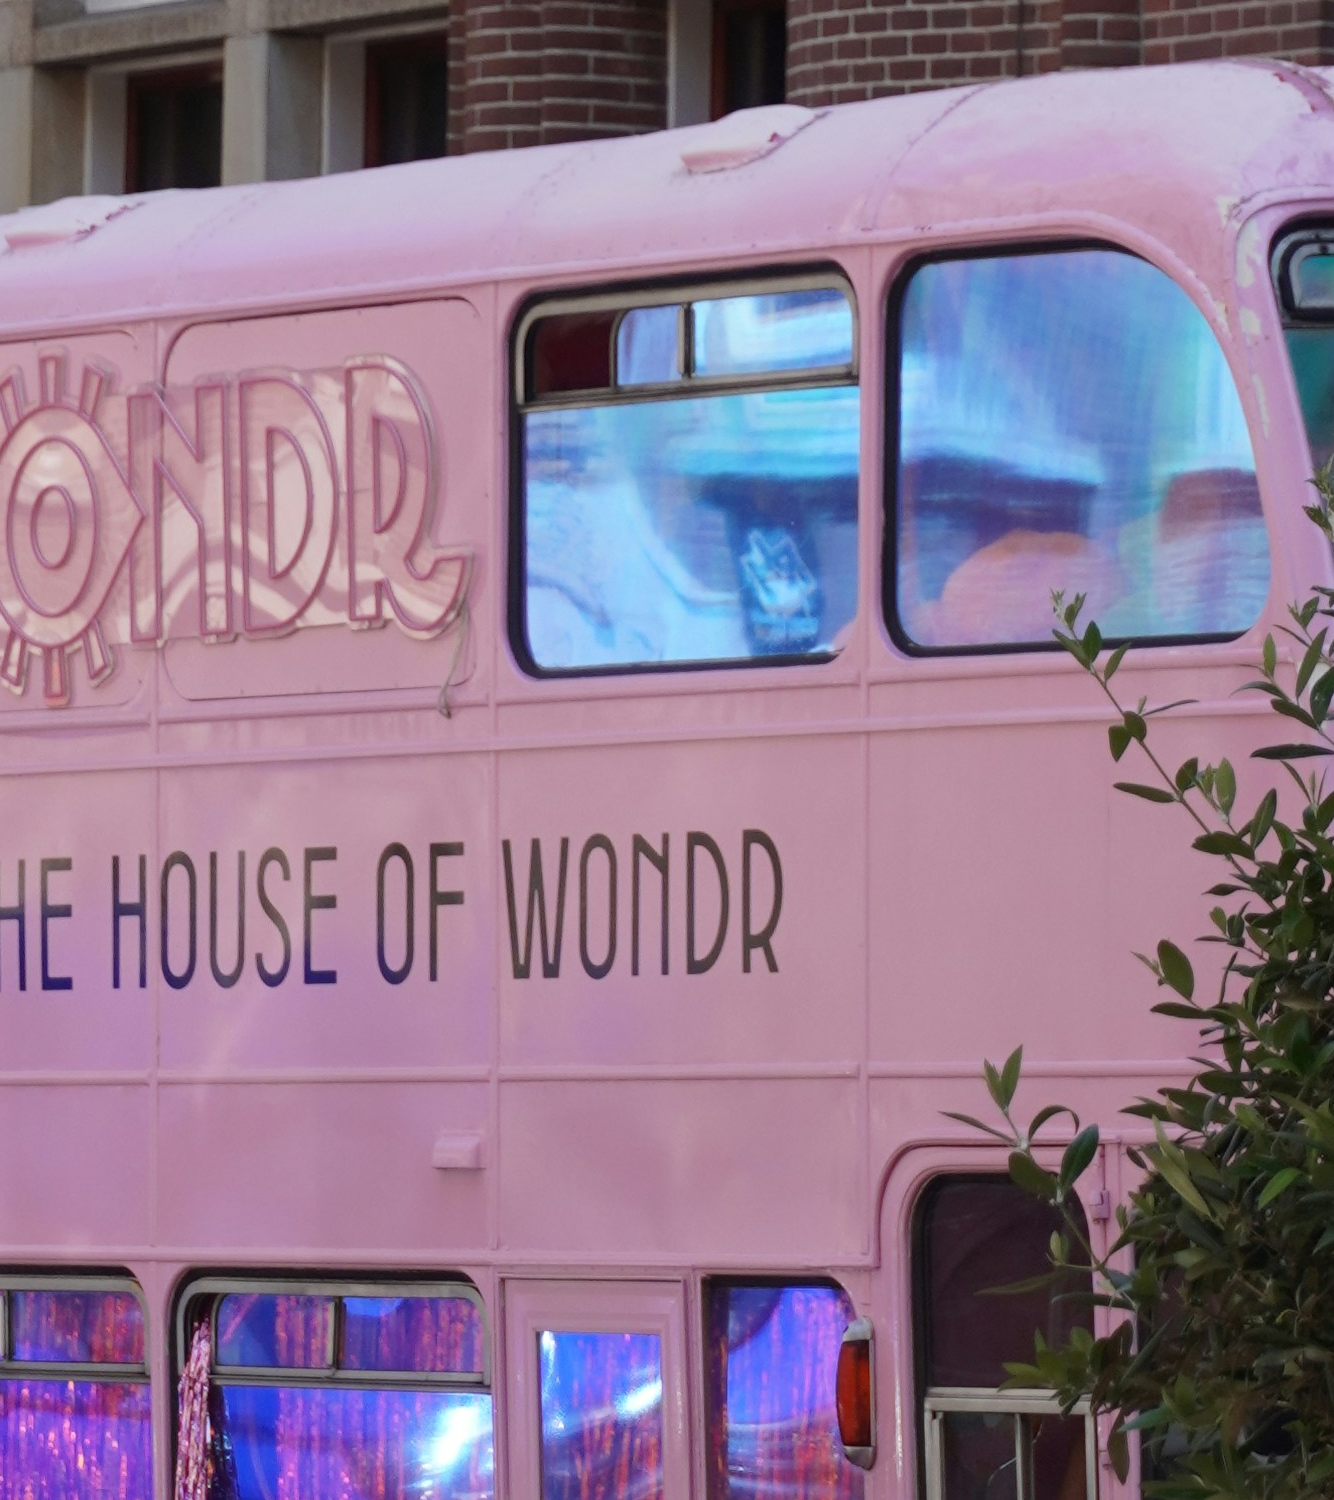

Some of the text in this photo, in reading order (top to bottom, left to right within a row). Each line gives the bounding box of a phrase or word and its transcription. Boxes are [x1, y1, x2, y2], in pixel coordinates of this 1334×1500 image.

[111, 846, 338, 991] HOUSE
[376, 841, 465, 986] OF
[501, 828, 784, 981] WONDR
